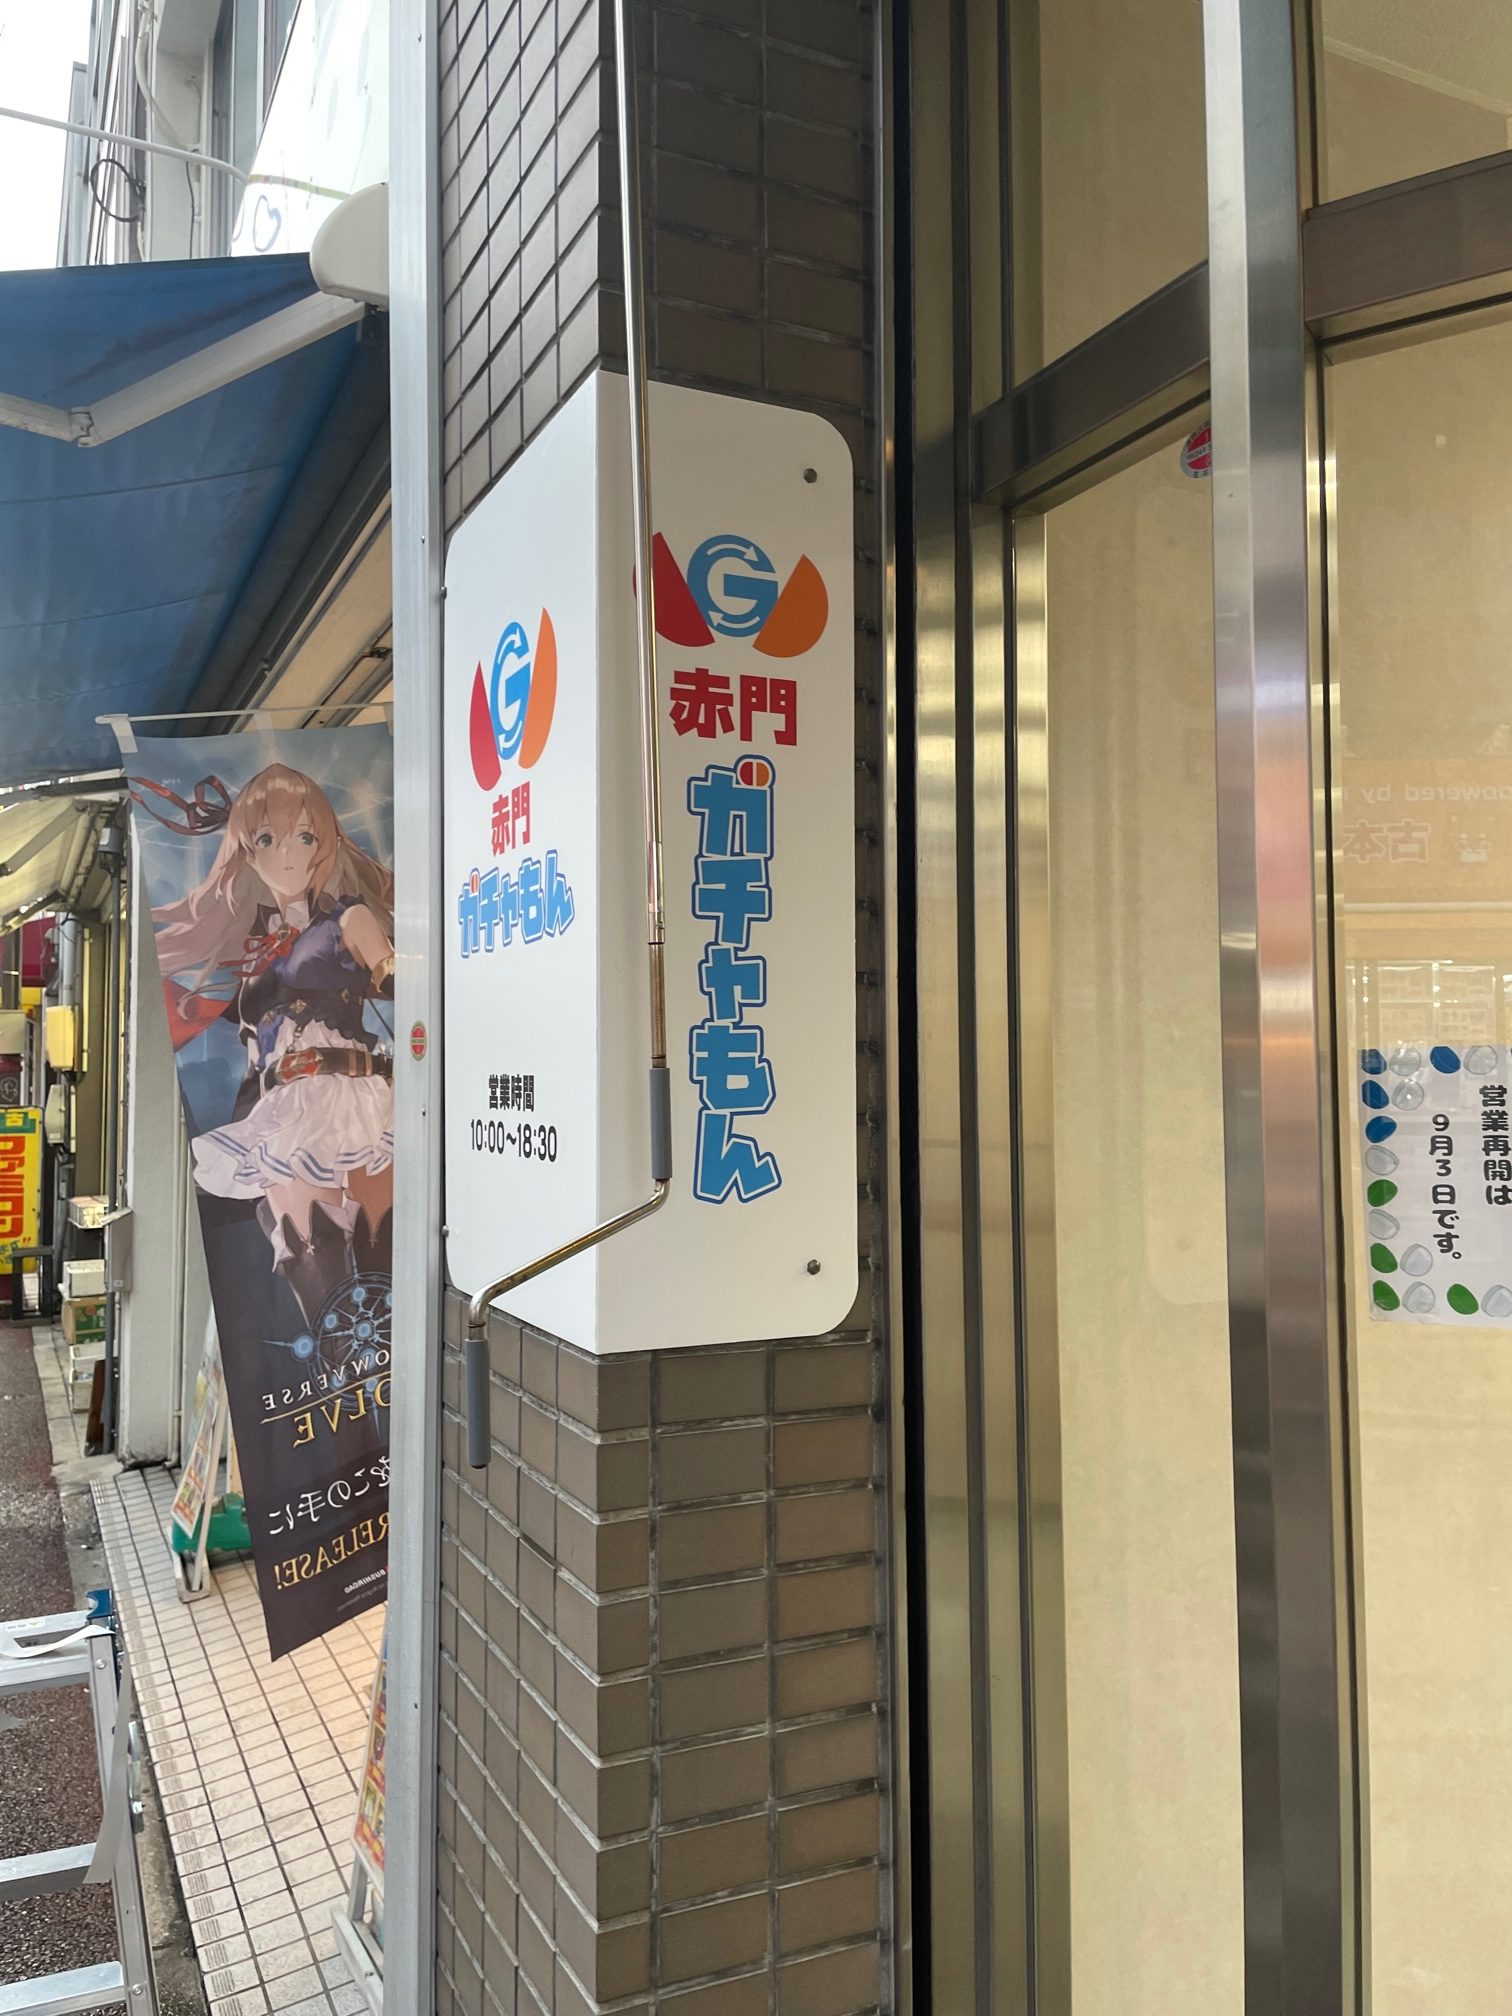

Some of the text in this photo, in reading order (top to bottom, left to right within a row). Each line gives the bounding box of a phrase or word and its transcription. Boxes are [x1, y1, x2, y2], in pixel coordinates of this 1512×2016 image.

[687, 534, 779, 638] G
[490, 621, 531, 760] G
[668, 667, 798, 747] 赤門
[491, 781, 531, 857] 赤門
[488, 1073, 535, 1112] 営業時間
[1428, 1113, 1463, 1260] 9月3日です。
[1479, 1085, 1512, 1206] 営業再開は
